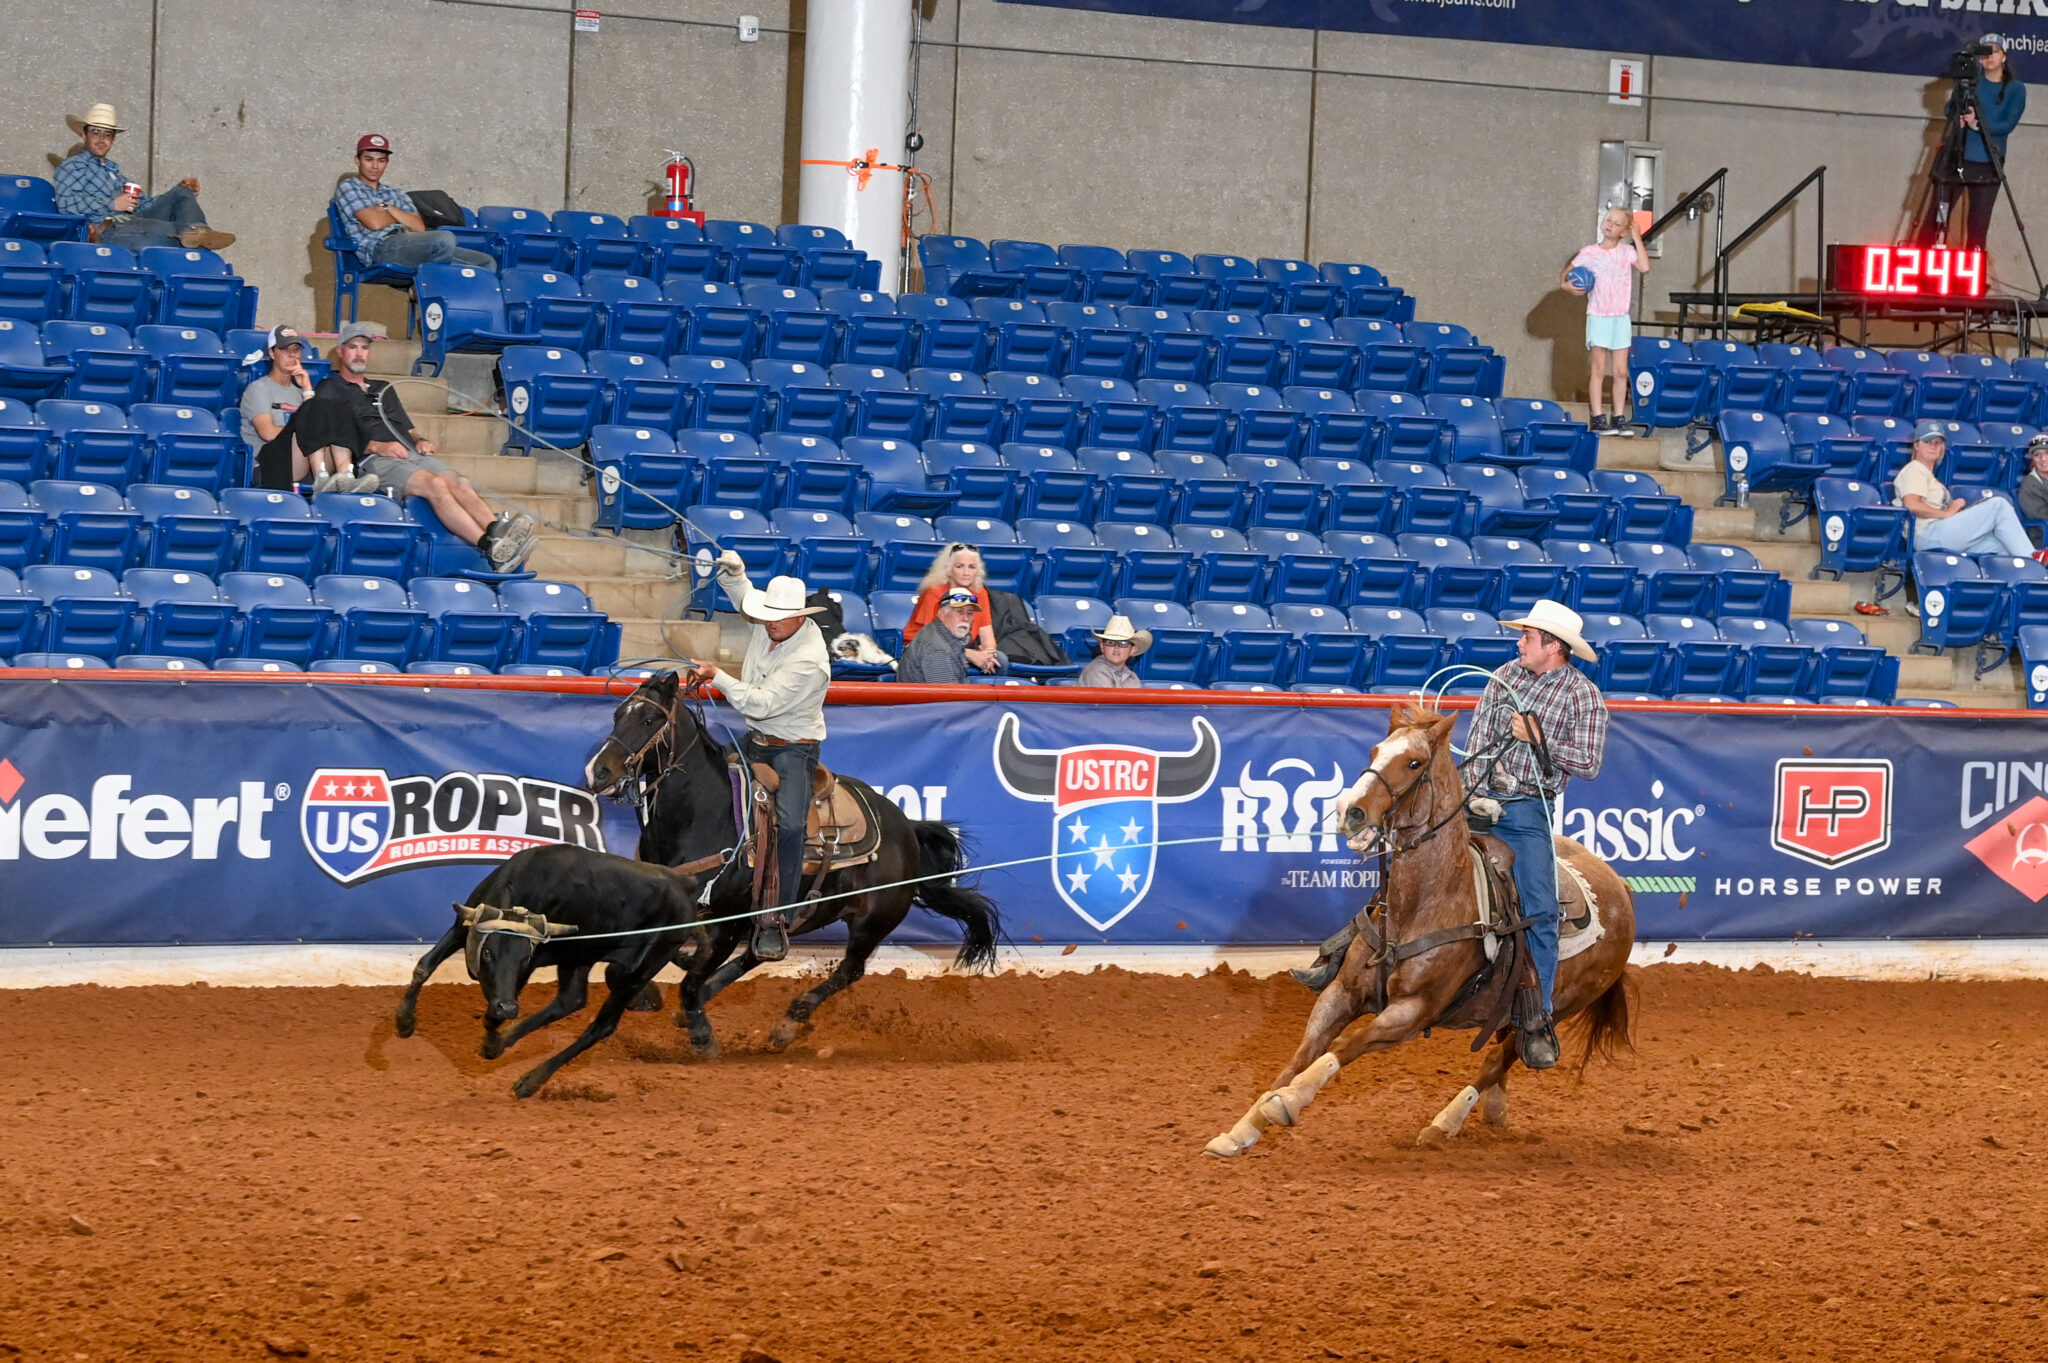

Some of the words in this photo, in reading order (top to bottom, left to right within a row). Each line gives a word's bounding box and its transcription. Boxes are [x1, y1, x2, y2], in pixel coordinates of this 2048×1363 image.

[1865, 247, 1981, 296] 0.244
[1065, 758, 1149, 792] USTRC
[1960, 760, 2048, 830] CIN
[315, 810, 379, 853] US
[391, 776, 600, 853] ROPER
[389, 837, 480, 859] ROADSIDE
[1288, 870, 1337, 888] TEAM
[1714, 877, 1821, 896] HORSE
[1834, 876, 1943, 895] POWER
